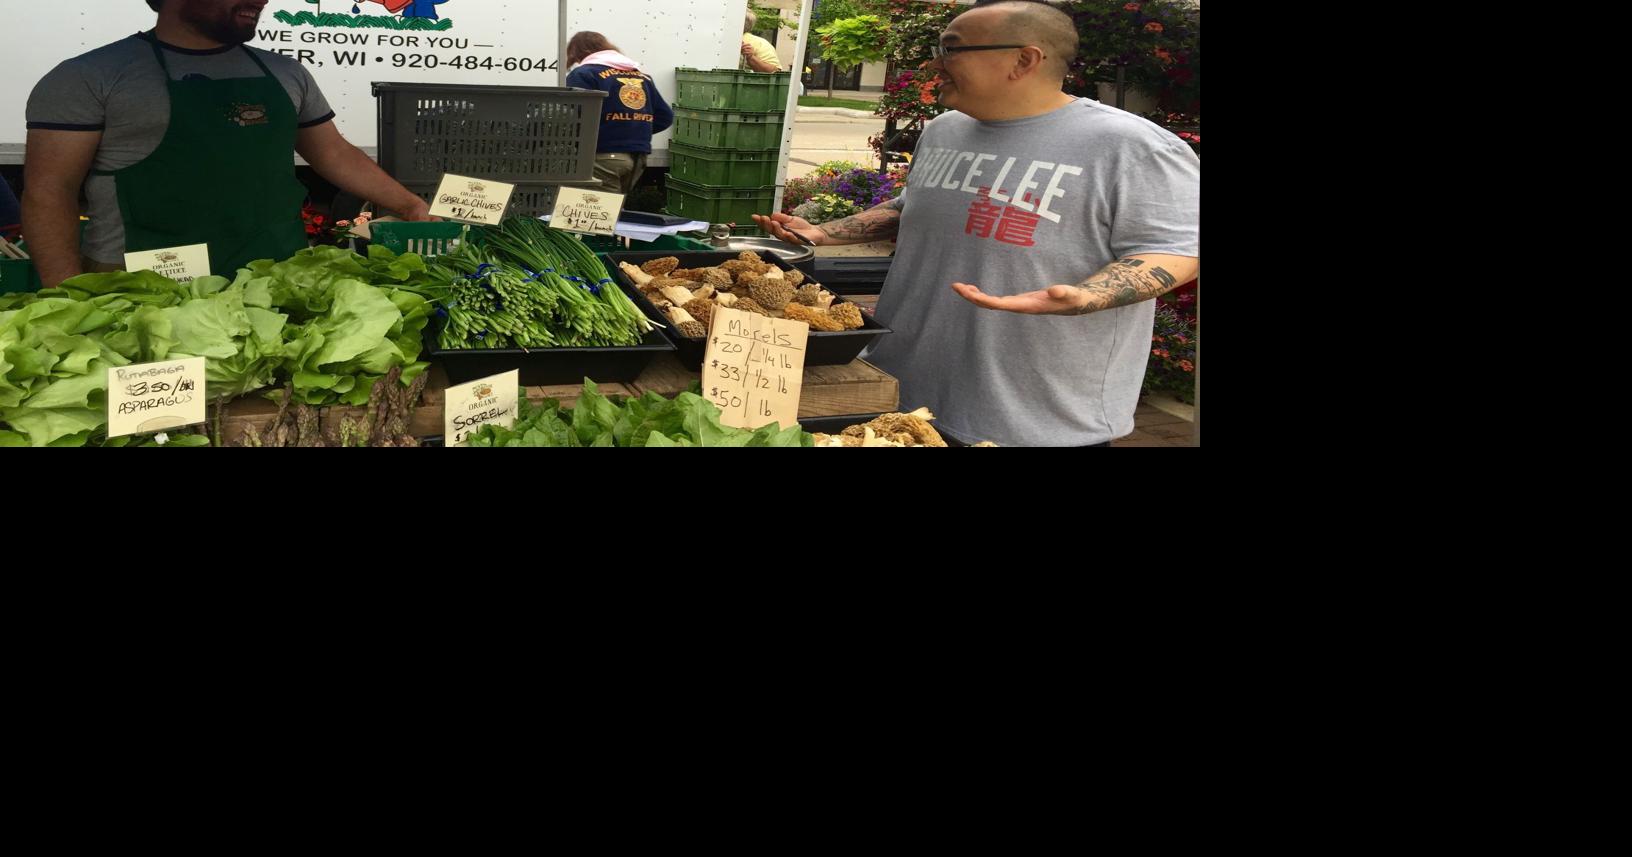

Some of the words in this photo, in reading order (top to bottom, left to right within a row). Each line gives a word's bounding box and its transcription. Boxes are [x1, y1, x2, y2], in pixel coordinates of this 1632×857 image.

[258, 29, 293, 42] WE
[300, 31, 369, 45] GROW
[377, 34, 419, 48] FOR
[426, 36, 469, 49] YOU
[270, 48, 324, 68] ER,
[332, 50, 366, 66] WI
[391, 52, 559, 73] 920-484-6044
[606, 112, 632, 121] FALL
[987, 156, 1083, 224] LEE
[439, 193, 470, 207] GARLIC
[470, 198, 503, 212] CHIVES
[561, 204, 609, 221] CHIVES
[152, 261, 185, 270] ORGANIC
[728, 319, 793, 346] Morels
[118, 392, 193, 415] ASPARAGUS
[452, 407, 509, 431] SORREL
